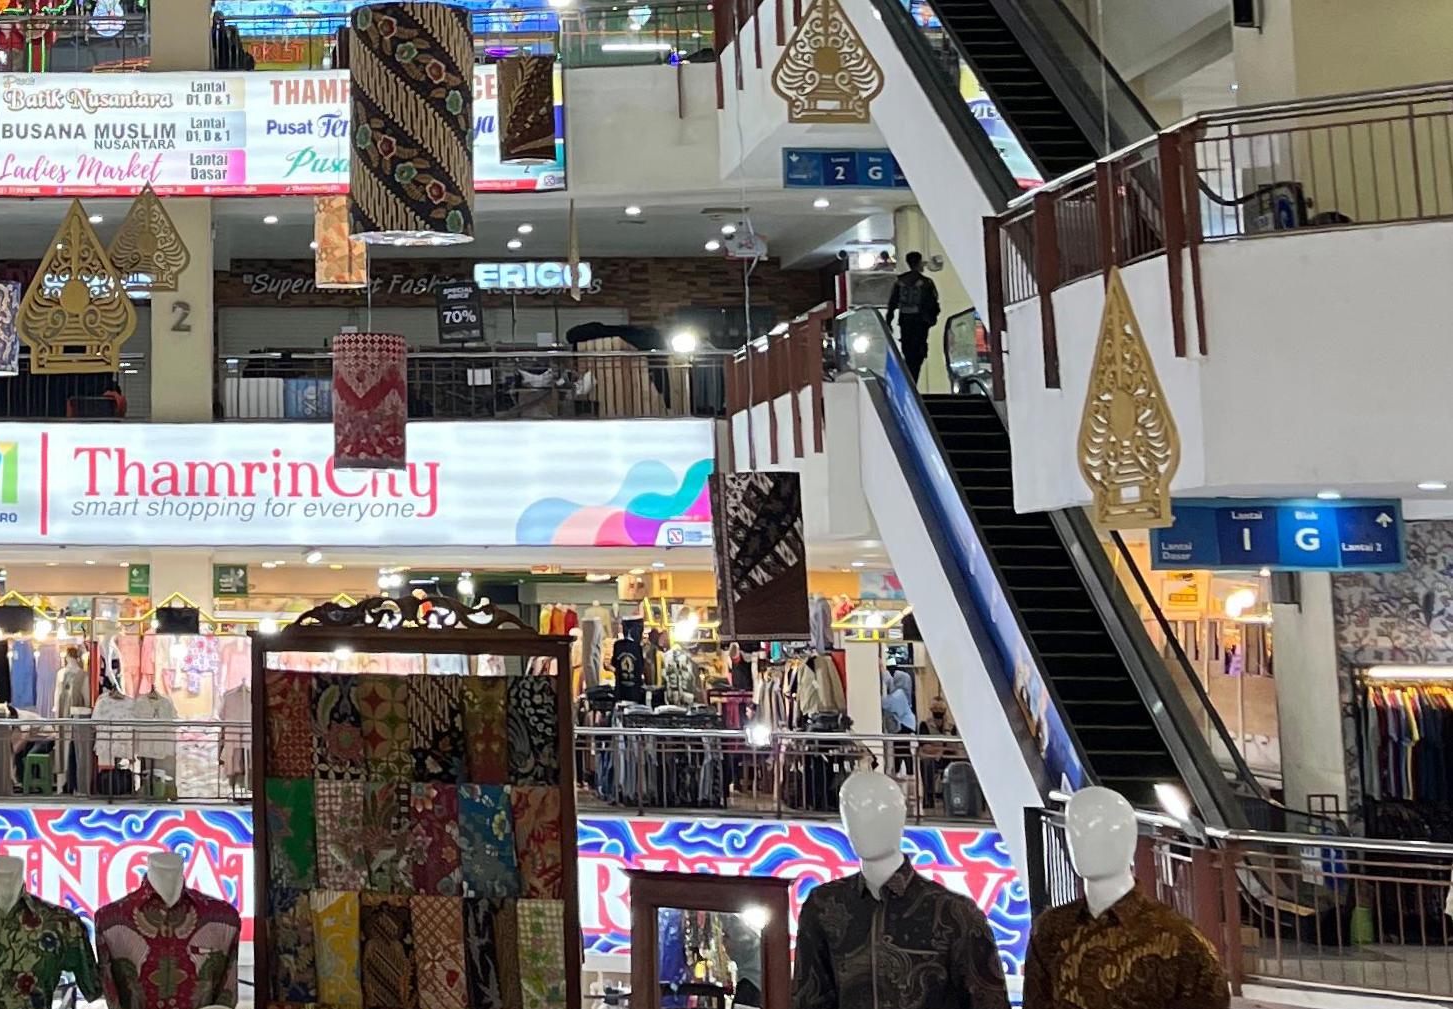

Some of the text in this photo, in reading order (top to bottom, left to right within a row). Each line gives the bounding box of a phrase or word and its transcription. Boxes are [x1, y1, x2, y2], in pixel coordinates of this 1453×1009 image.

[190, 81, 227, 93] Lantai
[3, 88, 174, 114] Batik Nusantara
[190, 117, 226, 129] Lantai
[267, 119, 313, 135] Pusat
[1, 123, 176, 140] BUSANA MUSLIM
[94, 139, 176, 150] NUSANTARA
[189, 153, 228, 166] Lantai
[284, 145, 350, 178] Pusa
[0, 152, 164, 185] Ladies Market
[190, 167, 228, 180] Dasar
[835, 166, 883, 180] 2 G
[473, 262, 593, 289] ERICO
[170, 301, 192, 332] 2
[442, 310, 477, 324] 70%
[71, 496, 415, 522] smart shopping for everyone
[1231, 510, 1264, 520] Lantai
[1161, 541, 1193, 551] Lantai
[1341, 542, 1373, 552] Lantai
[1294, 527, 1321, 551] G
